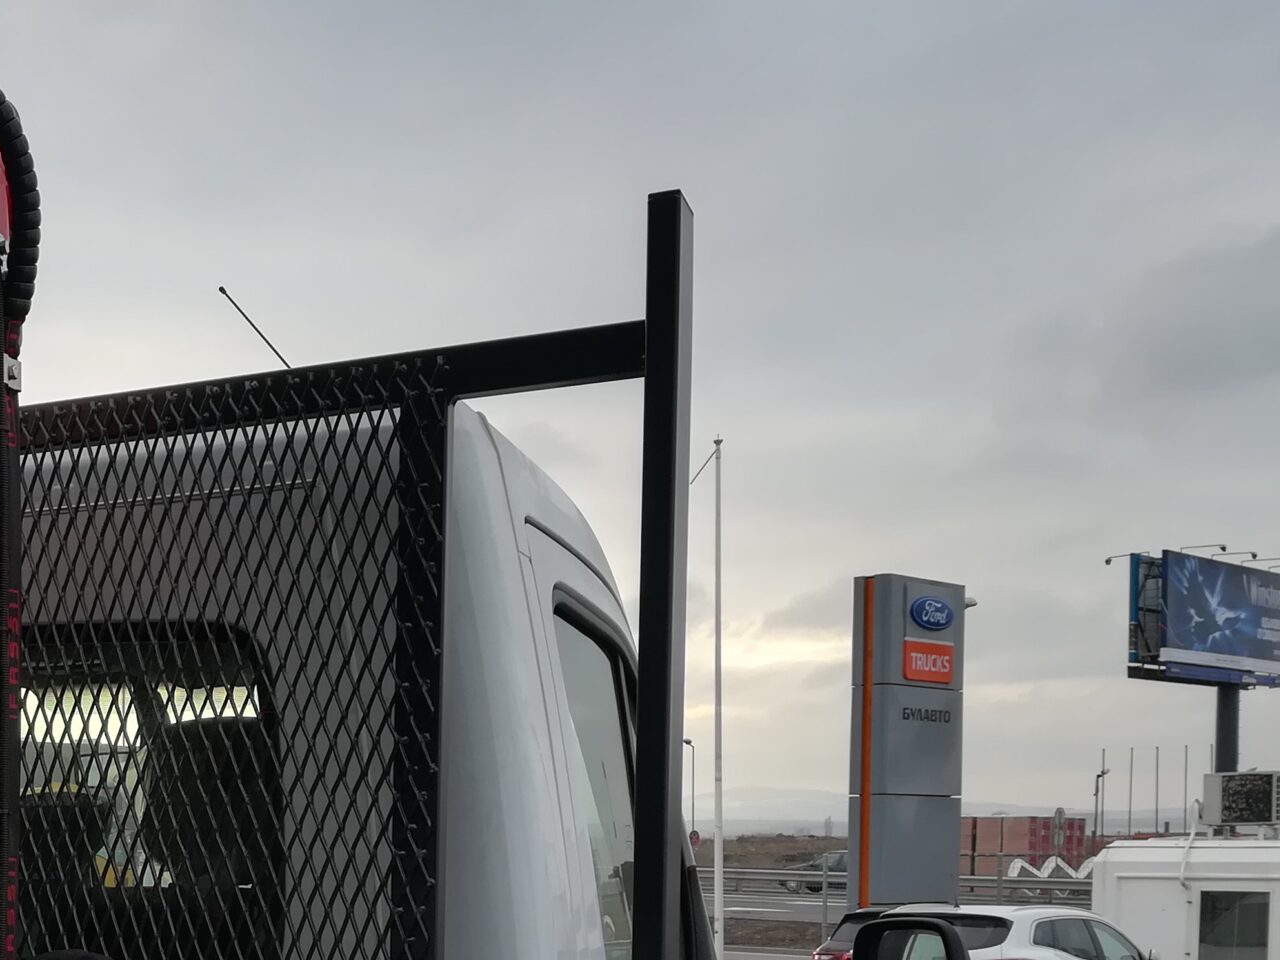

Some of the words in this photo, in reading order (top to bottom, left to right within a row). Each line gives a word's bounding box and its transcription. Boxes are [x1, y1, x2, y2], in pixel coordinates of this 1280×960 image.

[922, 600, 948, 623] Ford
[910, 652, 950, 673] TRUCKS
[902, 707, 951, 724] БУЛАВТО
